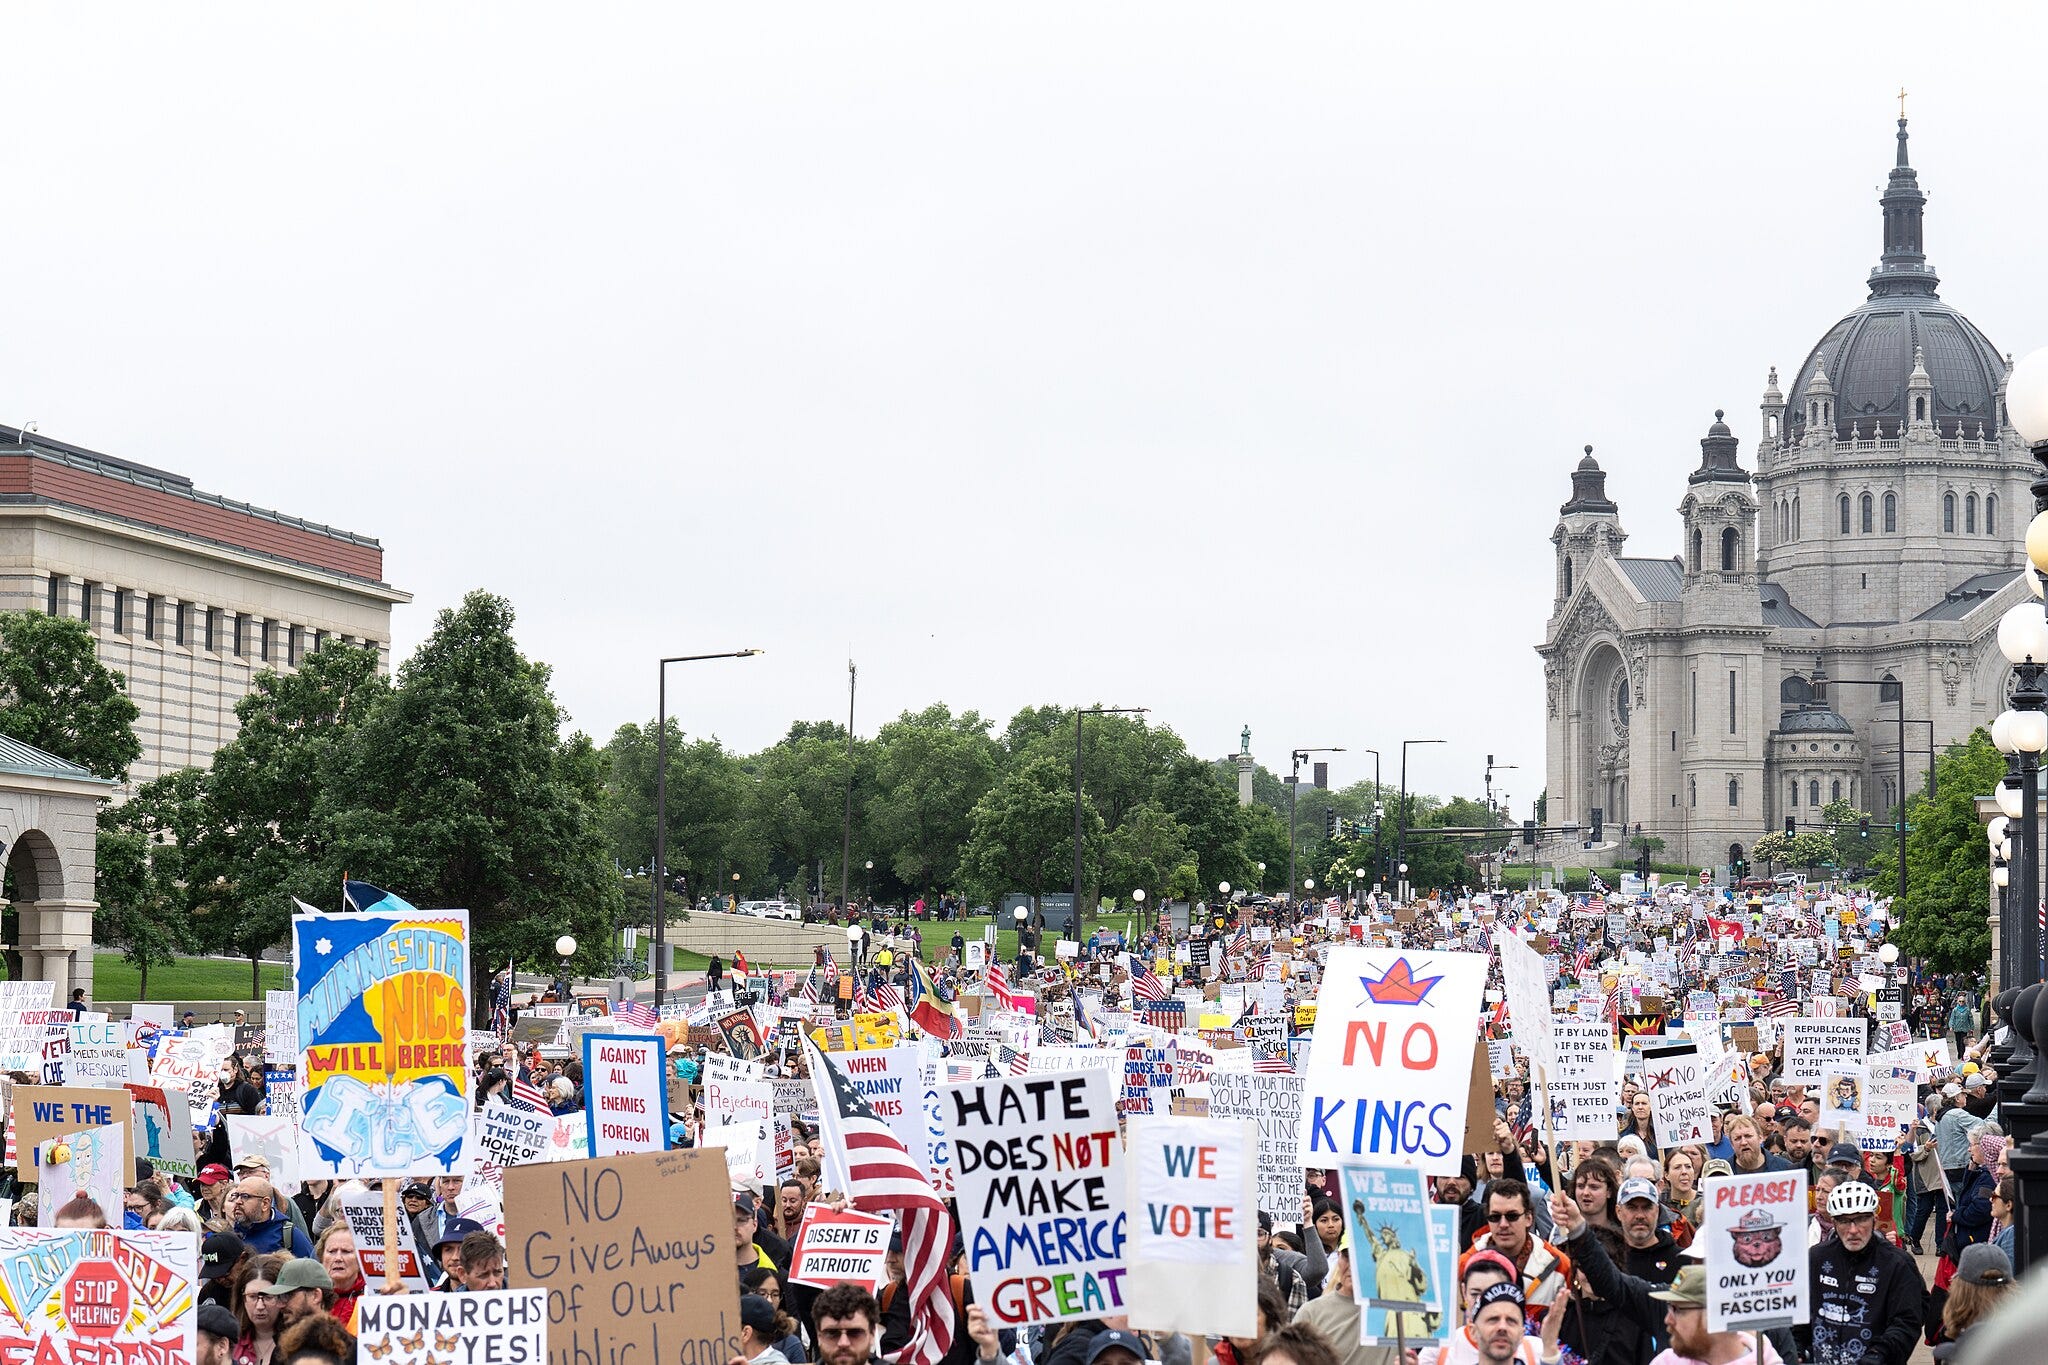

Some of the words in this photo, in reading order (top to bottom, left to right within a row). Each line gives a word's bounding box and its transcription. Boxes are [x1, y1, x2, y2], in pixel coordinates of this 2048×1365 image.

[297, 929, 464, 1054] MINNESOTA
[1684, 1012, 1718, 1020] QUEER
[1816, 1000, 1834, 1018] NO
[1554, 1028, 1564, 1037] IF
[1567, 1028, 1580, 1037] BY
[1582, 1028, 1608, 1037] LAND
[1794, 1026, 1862, 1034] REPUBLICANS
[1342, 1020, 1438, 1071] NO
[1560, 1042, 1570, 1050] IF
[1574, 1042, 1585, 1050] BY
[1588, 1042, 1608, 1051] SEA
[1826, 1037, 1861, 1045] SPINES
[73, 1050, 98, 1059] MELTS
[102, 1050, 126, 1060] UNDER
[307, 1047, 382, 1071] WILL
[399, 1043, 467, 1068] BREAK
[600, 1046, 648, 1066] AGAINST
[1126, 1048, 1142, 1061] YOU
[1145, 1048, 1165, 1062] CAN
[1574, 1054, 1594, 1064] THE
[76, 1062, 128, 1078] PRESSURE
[154, 1057, 219, 1083] Pluribus
[847, 1056, 887, 1074] WHEN
[1124, 1061, 1156, 1074] CHOOSE
[1157, 1062, 1172, 1074] TO
[609, 1068, 628, 1085] ALL
[1125, 1073, 1148, 1086] LOOK
[1150, 1074, 1173, 1088] AWAY
[1209, 1072, 1233, 1088] GIVE
[1236, 1074, 1249, 1088] ME
[1252, 1075, 1276, 1091] YOUR
[1675, 1066, 1696, 1086] NO
[1127, 1086, 1148, 1098] BUT
[1534, 1082, 1580, 1091] HGSETH
[1583, 1082, 1607, 1091] JUST
[600, 1094, 646, 1114] ENEMIES
[710, 1084, 768, 1120] Rejecting
[950, 1078, 1090, 1127] HATE
[1210, 1088, 1251, 1107] YOUR
[1260, 1090, 1301, 1110] POOR
[1572, 1097, 1608, 1106] TEXTED
[32, 1102, 64, 1123] WE
[71, 1103, 112, 1125] THE
[486, 1108, 522, 1127] LAND
[524, 1119, 543, 1132] OF
[1210, 1105, 1230, 1114] YOUR
[1233, 1106, 1266, 1117] HUDDLED
[1270, 1108, 1302, 1119] MASSES
[302, 1075, 469, 1170] ICE
[1310, 1096, 1453, 1158] KINGS
[486, 1124, 517, 1142] THE
[514, 1130, 548, 1149] FREE
[602, 1122, 650, 1144] FOREIGN
[1668, 1126, 1702, 1143] USA
[480, 1136, 520, 1156] HOME
[522, 1149, 538, 1160] OF
[954, 1134, 1048, 1175] DOES
[488, 1150, 520, 1167] THE
[655, 1154, 676, 1166] SAVE
[681, 1152, 700, 1161] THE
[1164, 1144, 1218, 1180] WE
[660, 1164, 691, 1177] BWCA
[1268, 1174, 1303, 1183] HOMELESS
[1275, 1183, 1286, 1194] TO
[1348, 1170, 1388, 1194] WE
[1390, 1182, 1416, 1196] THE
[562, 1167, 623, 1225] NO
[983, 1176, 1110, 1219] MAKE
[1268, 1196, 1301, 1211] LAMP
[1715, 1178, 1798, 1210] PLEASE!
[346, 1206, 364, 1216] END
[1368, 1197, 1422, 1214] PEOPLE
[352, 1216, 379, 1226] RAIDS
[1148, 1202, 1234, 1240] VOTE
[1282, 1212, 1303, 1222] DOOR
[78, 1230, 113, 1258] YOUR
[807, 1228, 860, 1244] DISSENT
[865, 1230, 879, 1244] IS
[972, 1212, 1127, 1272] AMERICA
[804, 1258, 872, 1274] PATRIOTIC
[1719, 1272, 1760, 1290] ONLY
[1766, 1269, 1796, 1284] YOU
[74, 1279, 118, 1305] STOP
[992, 1268, 1127, 1324] GREAT
[1733, 1290, 1748, 1299] CAN
[1750, 1288, 1782, 1297] PREVENT
[69, 1304, 122, 1327] HELPING
[360, 1296, 544, 1334] MONARCHS
[1720, 1296, 1798, 1316] FASCISM
[462, 1333, 540, 1365] YES!
